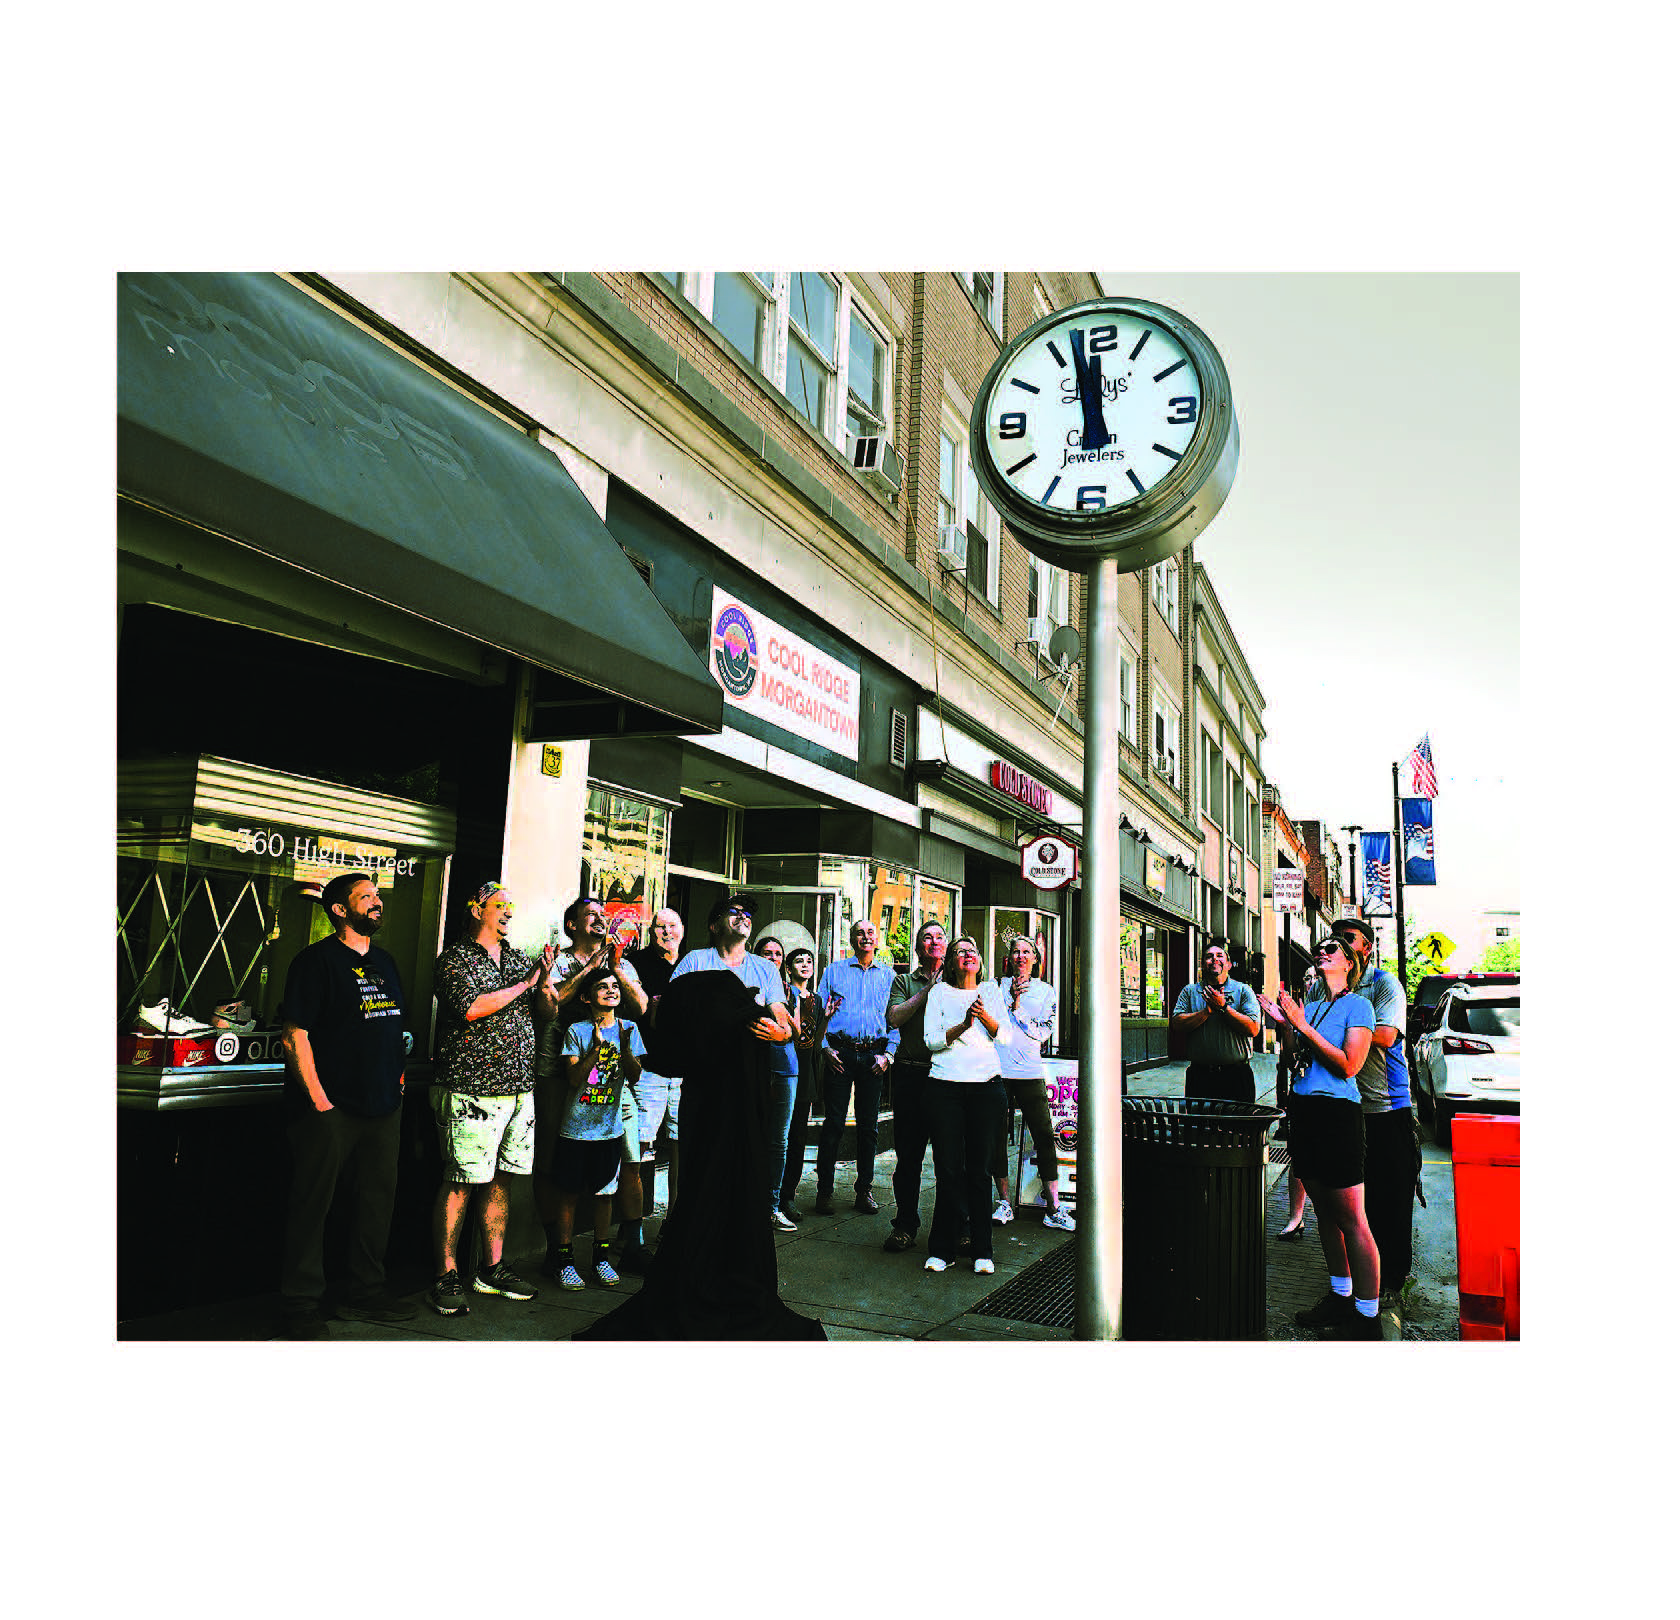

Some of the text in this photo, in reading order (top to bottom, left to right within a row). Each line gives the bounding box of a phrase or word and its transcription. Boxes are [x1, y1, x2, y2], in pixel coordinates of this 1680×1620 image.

[1167, 396, 1197, 424] 3
[999, 412, 1027, 440] 9
[1066, 429, 1118, 447] Crn
[1060, 448, 1125, 470] Jewelers
[768, 637, 849, 705] COOL RIDGE
[761, 671, 858, 741] MORGANTOWN
[235, 827, 418, 877] 360 High Street
[187, 1050, 205, 1060] NIKE
[580, 1095, 615, 1104] MARIO
[585, 1086, 613, 1096] SUPER
[1045, 1084, 1079, 1104] OP
